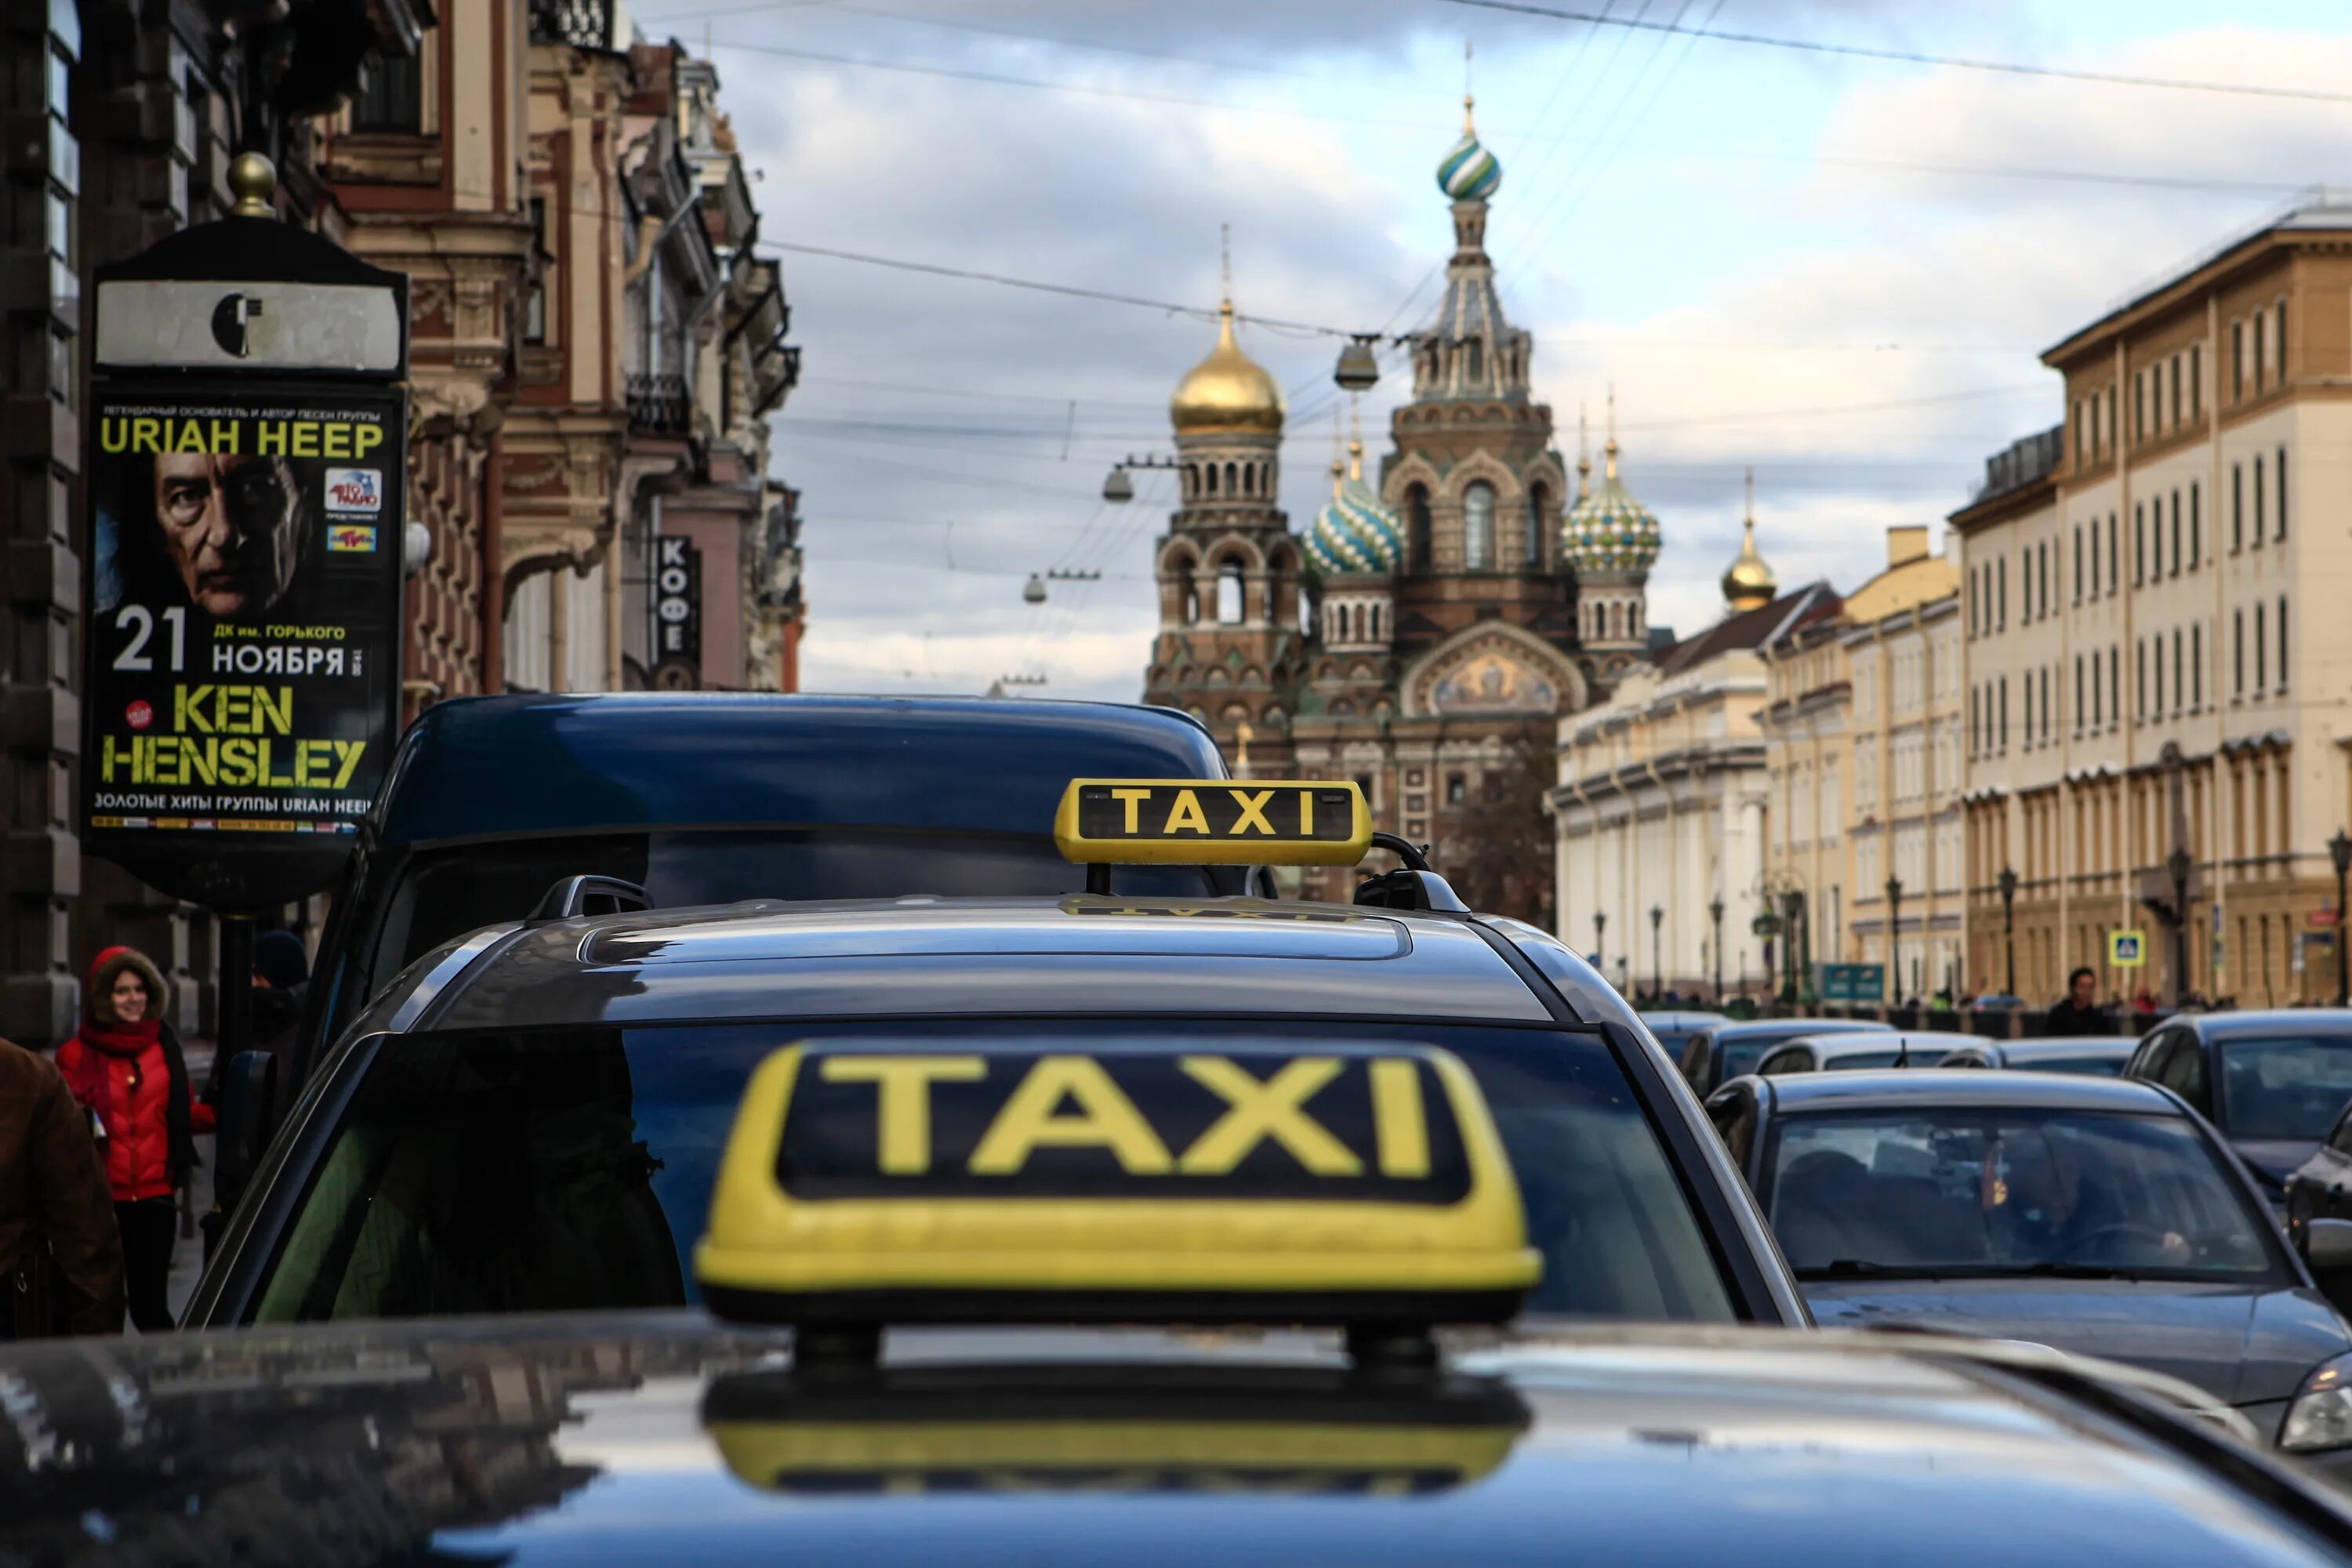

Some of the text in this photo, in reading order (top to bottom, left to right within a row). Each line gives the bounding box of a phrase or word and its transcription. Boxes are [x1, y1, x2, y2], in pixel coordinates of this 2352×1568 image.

[250, 408, 260, 418] И
[261, 408, 296, 419] АВТОР
[101, 417, 383, 459] URIAH HEEP
[113, 604, 186, 671] 21
[212, 623, 234, 638] ДК
[266, 624, 346, 641] ГОРЬКОГО
[212, 644, 344, 677] НОЯБРЯ
[174, 684, 293, 735] KEN
[102, 734, 367, 789] HENSLEY
[94, 793, 167, 809] ЗОЛОТЫЕ
[170, 794, 212, 811] ХИТЫ
[216, 796, 278, 813] ГРУППЫ
[282, 797, 331, 814] URIAH
[1111, 788, 1315, 836] TAXI
[817, 1055, 1433, 1179] TAXI
